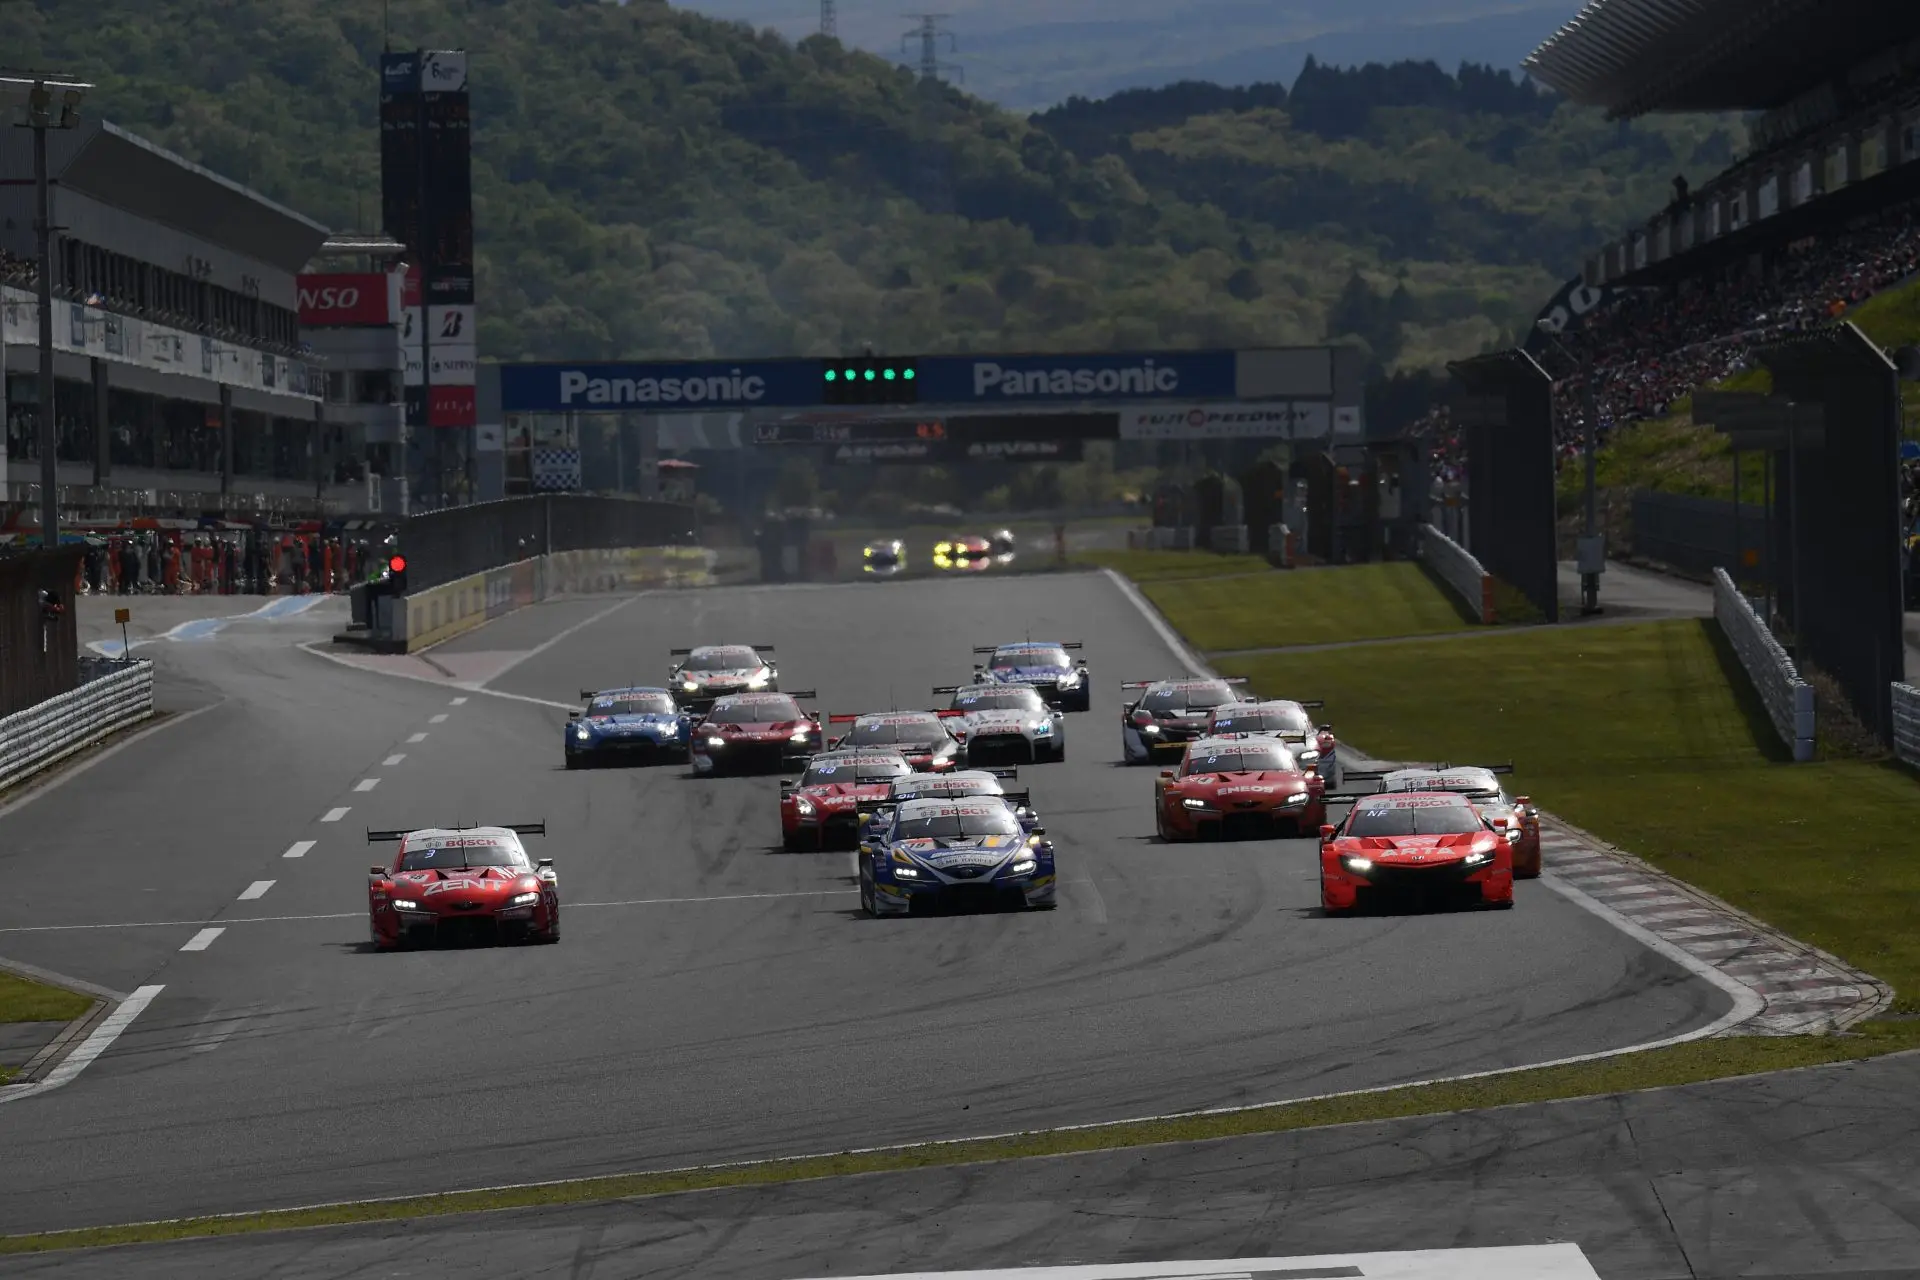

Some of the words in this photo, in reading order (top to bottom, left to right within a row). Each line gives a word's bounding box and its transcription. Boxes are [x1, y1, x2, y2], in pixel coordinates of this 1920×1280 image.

[443, 359, 474, 370] NIPPO
[973, 358, 1179, 396] Panasonic
[559, 367, 766, 404] Panasonic
[883, 717, 926, 725] BOSCH
[843, 758, 890, 766] BOSCH
[933, 781, 981, 789] BOSCH
[1427, 778, 1475, 786] BOSCH
[1216, 785, 1274, 796] ENEOS
[1395, 799, 1452, 808] BOSCH
[941, 808, 991, 816] BOSCH
[445, 839, 498, 847] BOSCH
[1379, 847, 1456, 858] ARTA
[421, 879, 508, 897] ZENT
